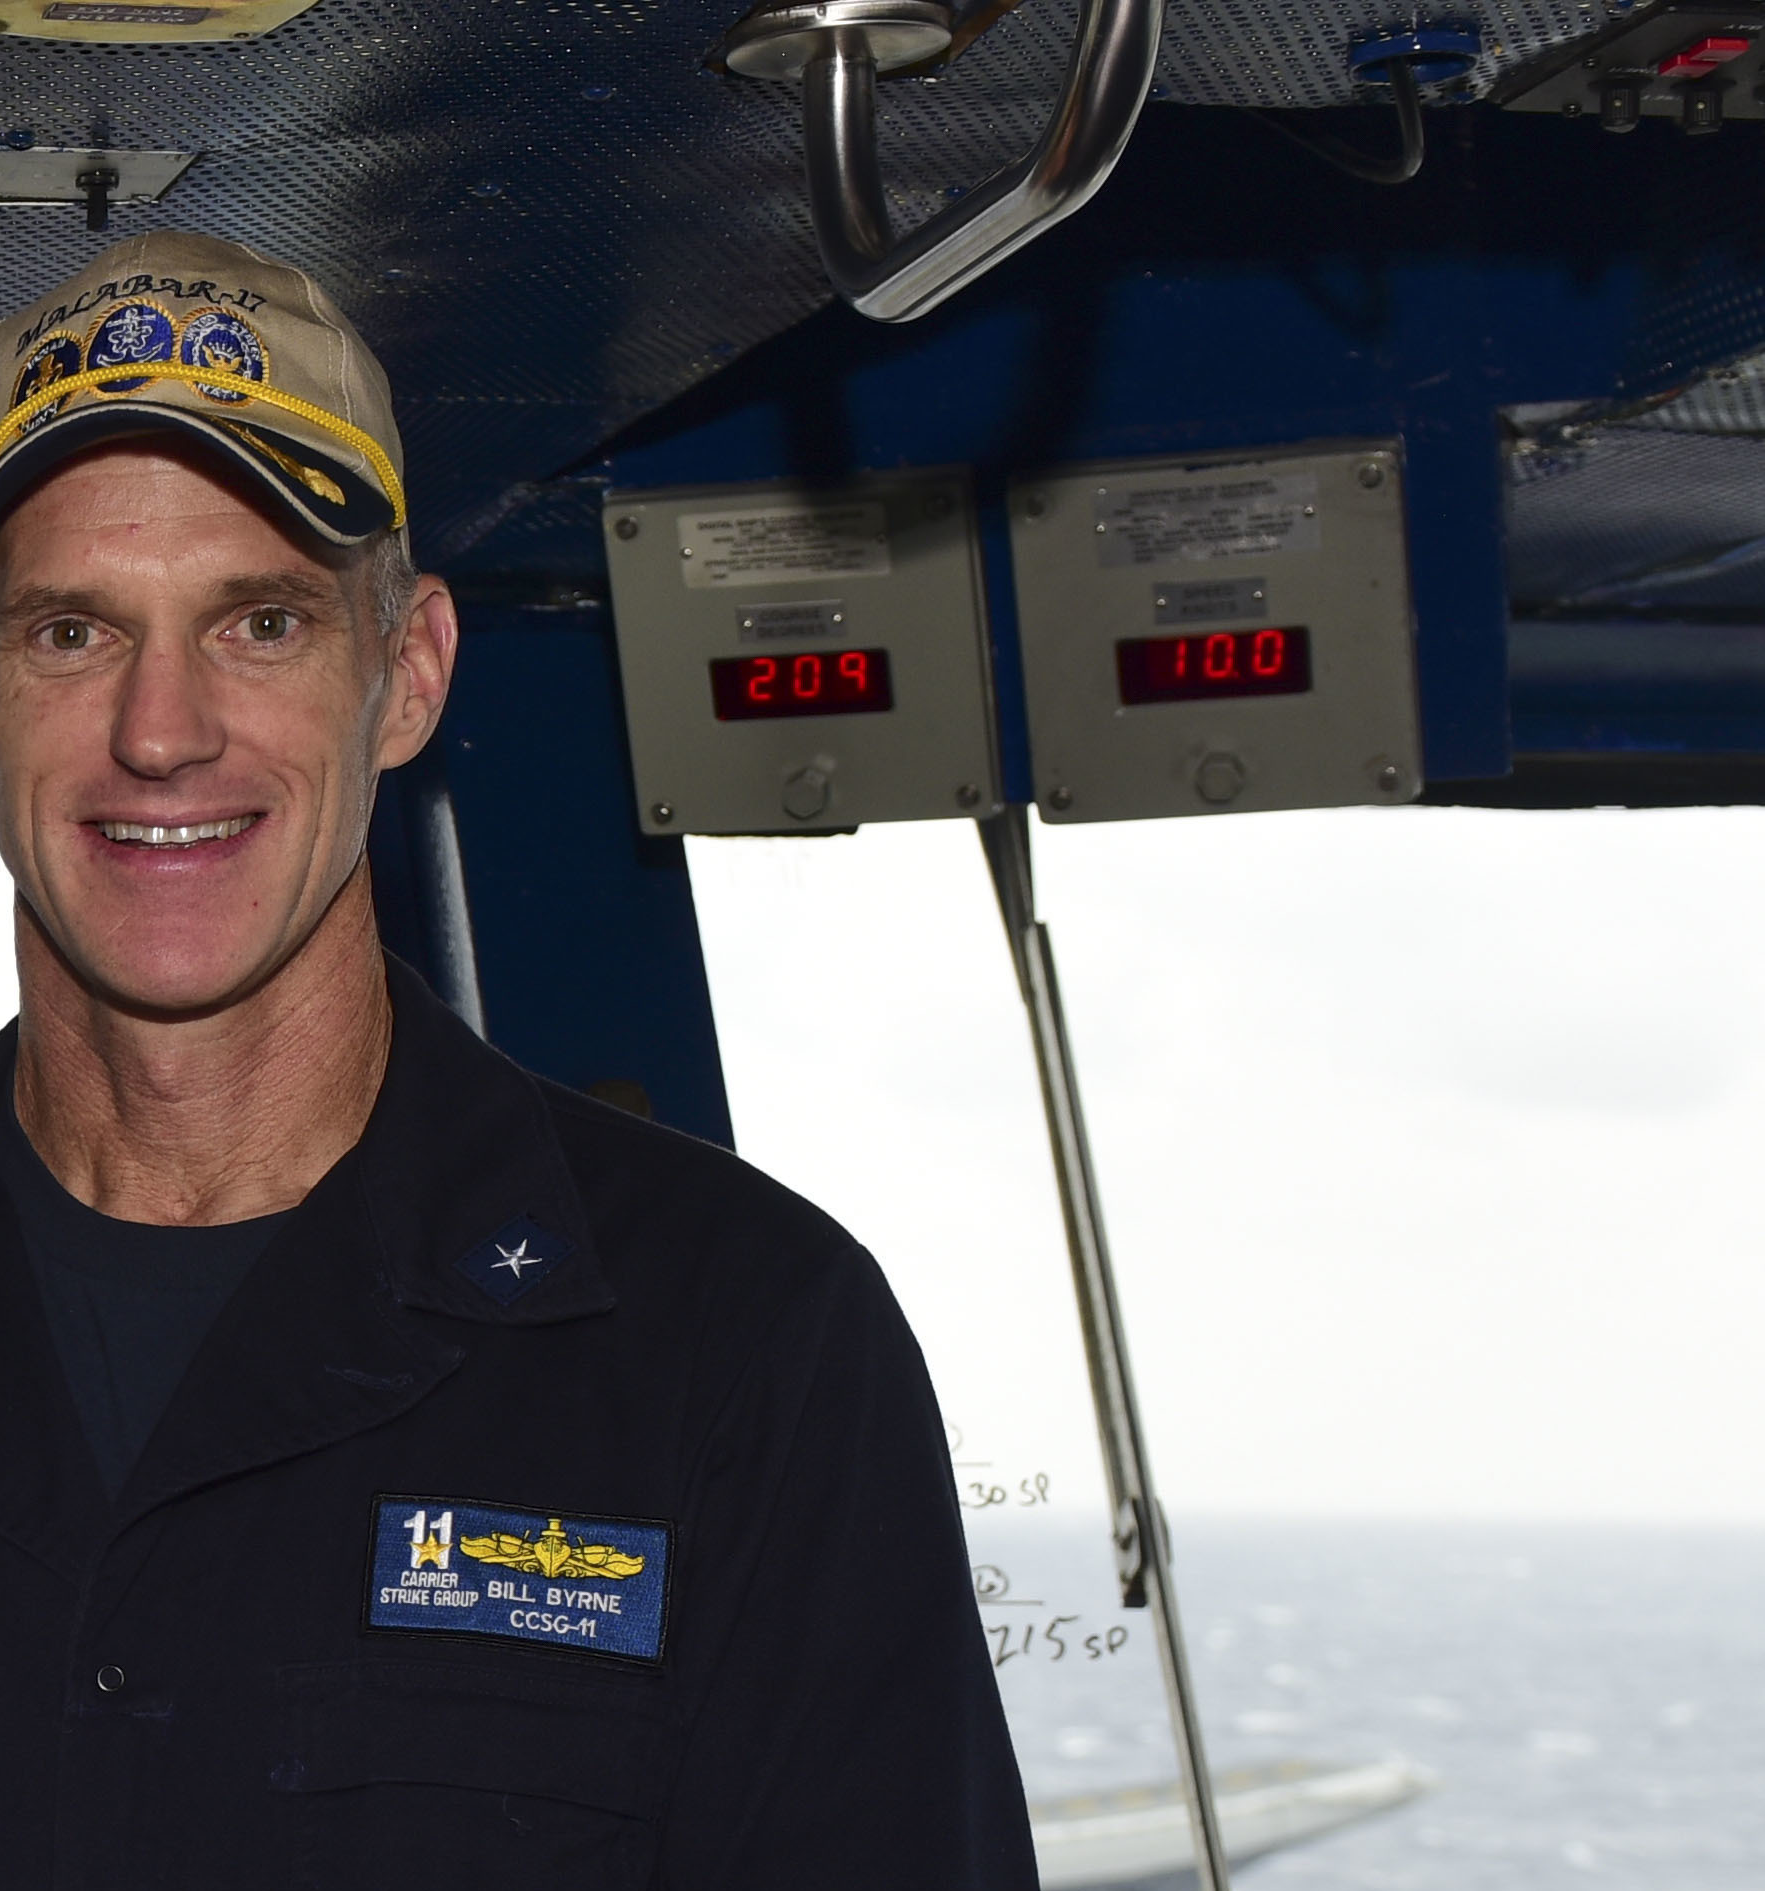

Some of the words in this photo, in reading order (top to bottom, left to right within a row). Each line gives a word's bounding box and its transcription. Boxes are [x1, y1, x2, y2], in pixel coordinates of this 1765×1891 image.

[15, 273, 268, 358] MALABAR-17
[747, 651, 868, 701] 209
[403, 1510, 454, 1570] 11
[379, 1587, 431, 1607] STRIKE
[432, 1589, 480, 1608] GROUP
[400, 1570, 459, 1590] CARRIER
[487, 1580, 537, 1603] BILL
[546, 1586, 623, 1615] BYRNE
[509, 1609, 598, 1639] CCSG-11
